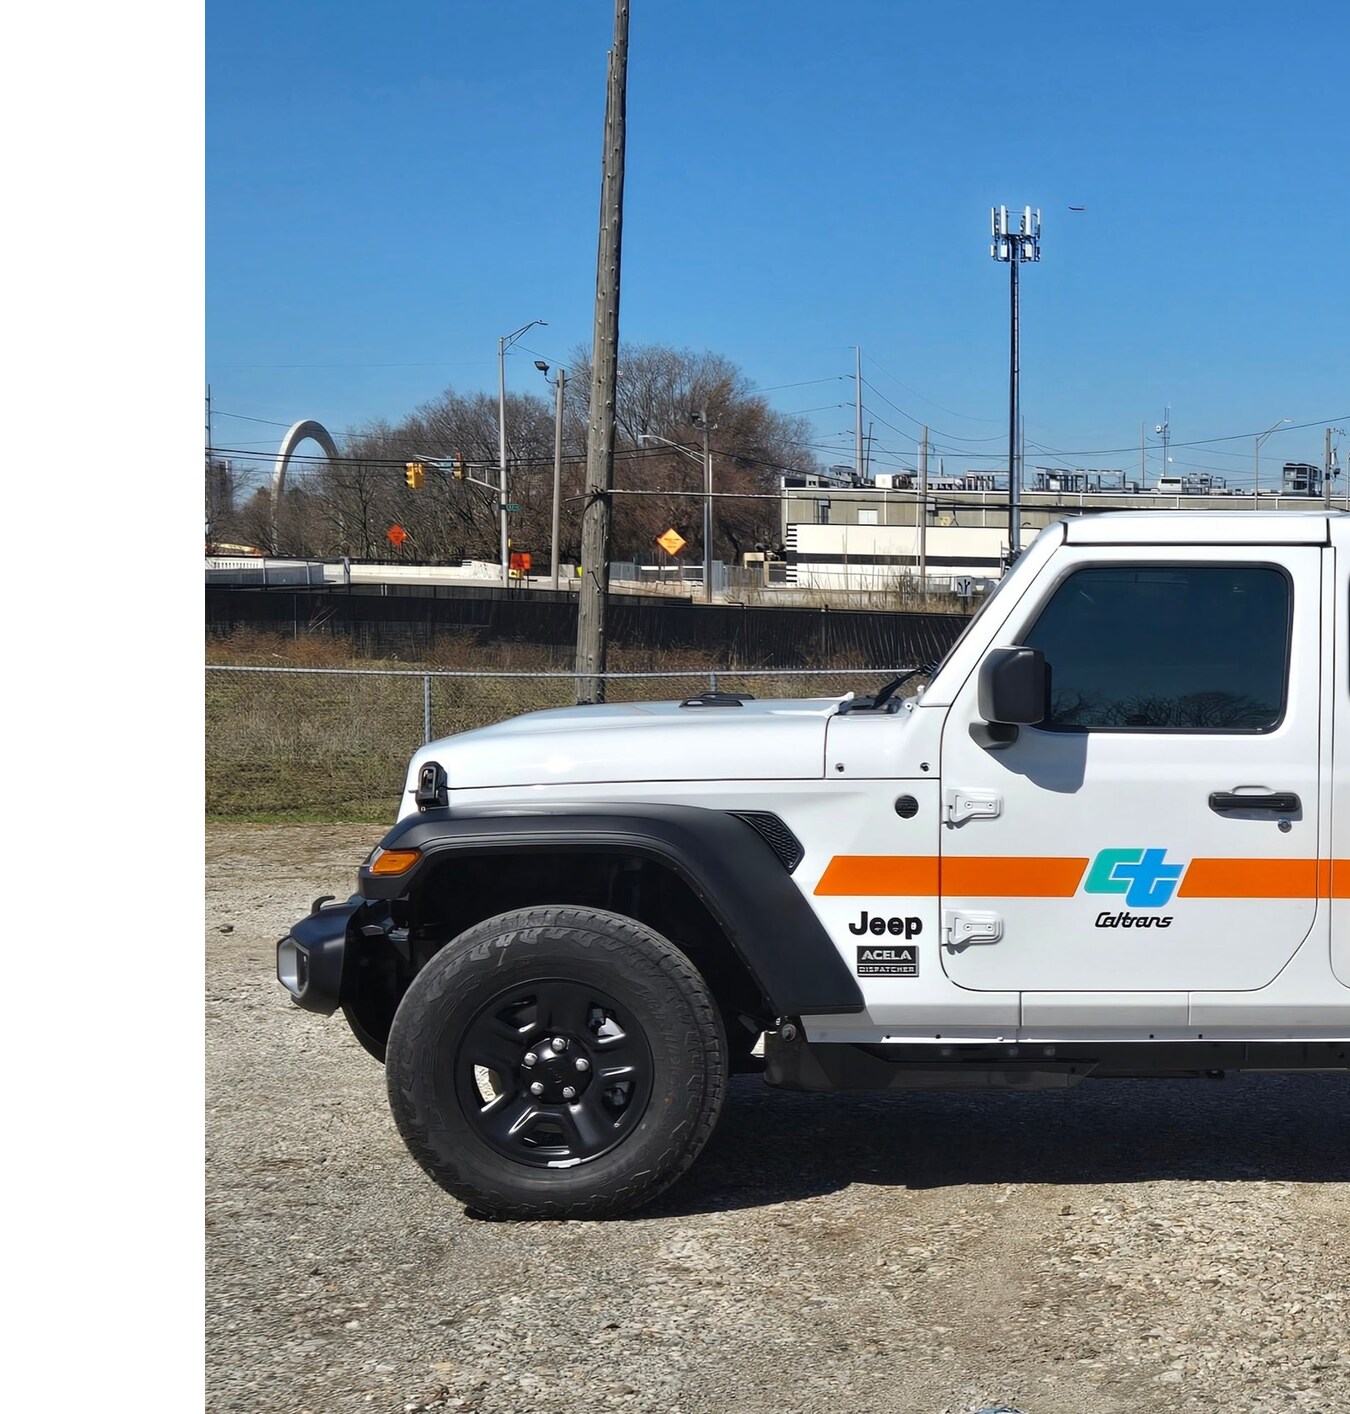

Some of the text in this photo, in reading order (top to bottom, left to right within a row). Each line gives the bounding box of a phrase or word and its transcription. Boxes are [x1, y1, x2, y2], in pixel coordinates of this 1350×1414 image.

[848, 911, 923, 940] Jeep
[1094, 912, 1174, 928] Caltrans
[861, 949, 913, 960] ACELA
